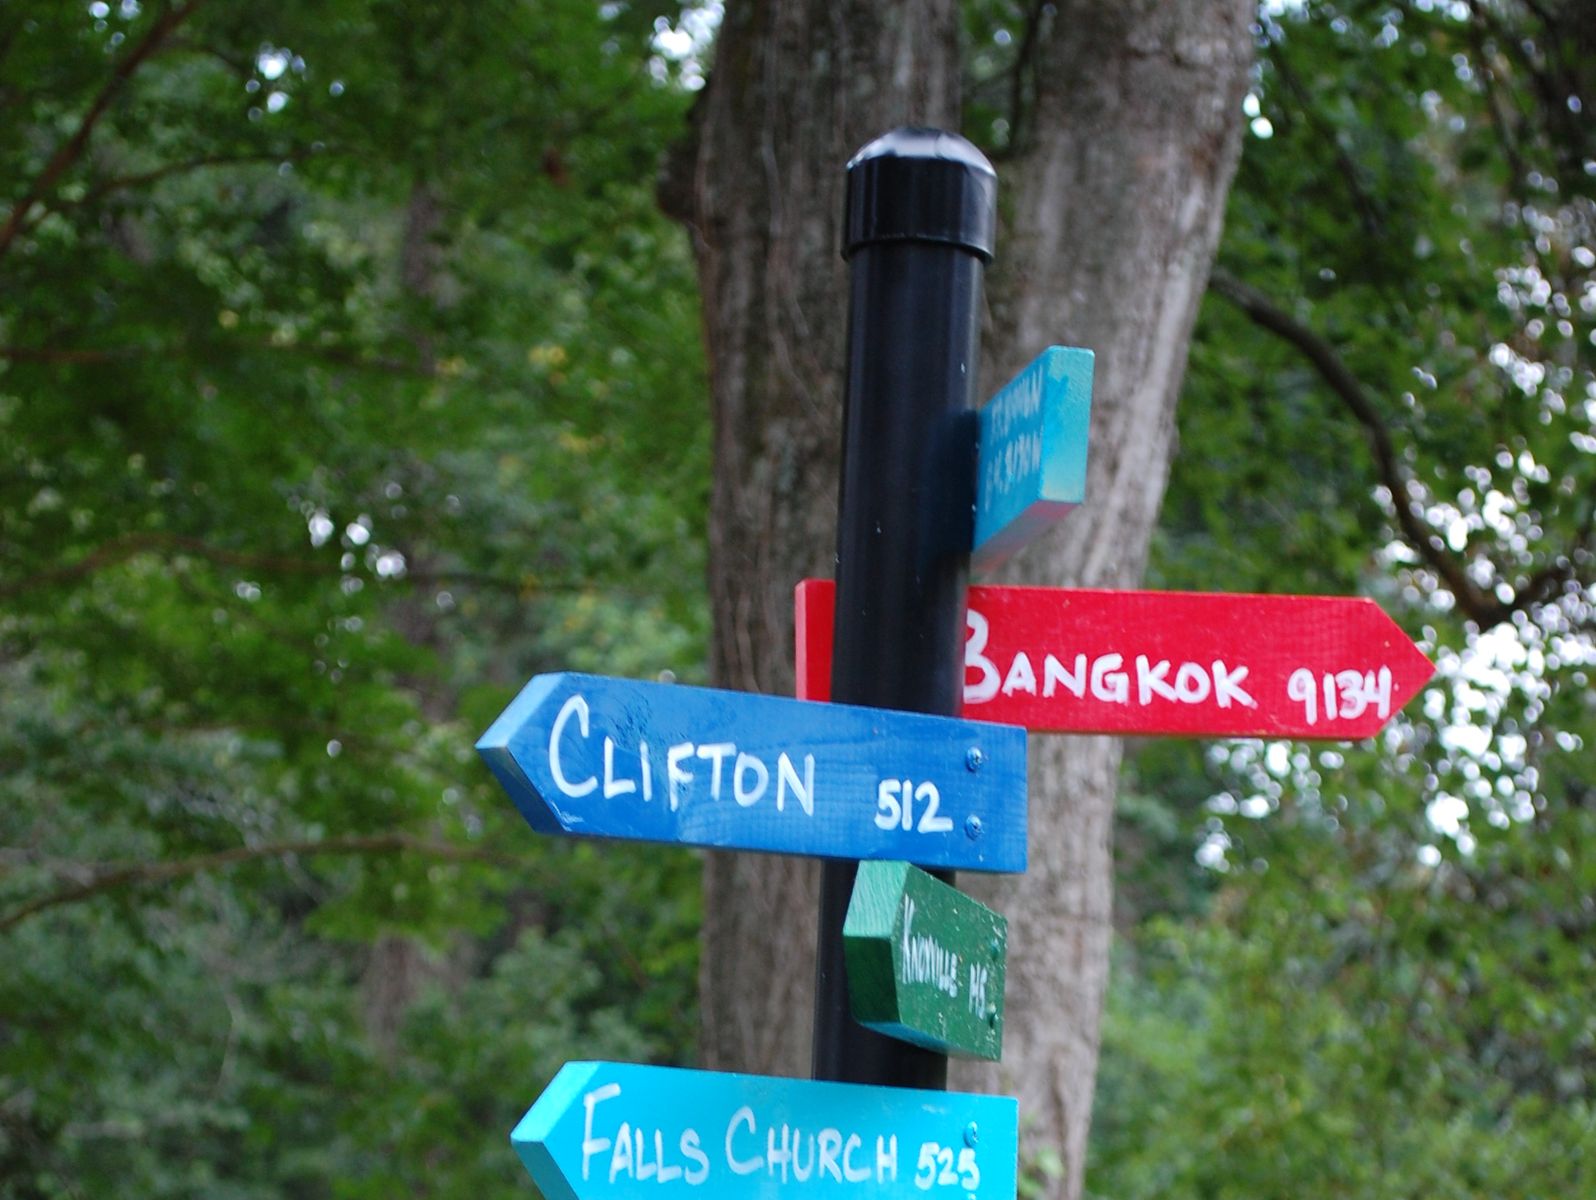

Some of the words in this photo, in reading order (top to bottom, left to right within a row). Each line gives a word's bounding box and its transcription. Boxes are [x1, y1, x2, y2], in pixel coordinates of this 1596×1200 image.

[964, 608, 1258, 709] BANGKOK
[1287, 665, 1393, 725] 9134
[548, 694, 816, 816] CLIFTON
[874, 778, 954, 833] 512
[902, 893, 957, 997] KNOXVILLE
[582, 1083, 710, 1186] FALLS
[725, 1106, 898, 1185] CHURCH
[914, 1141, 981, 1191] 525
